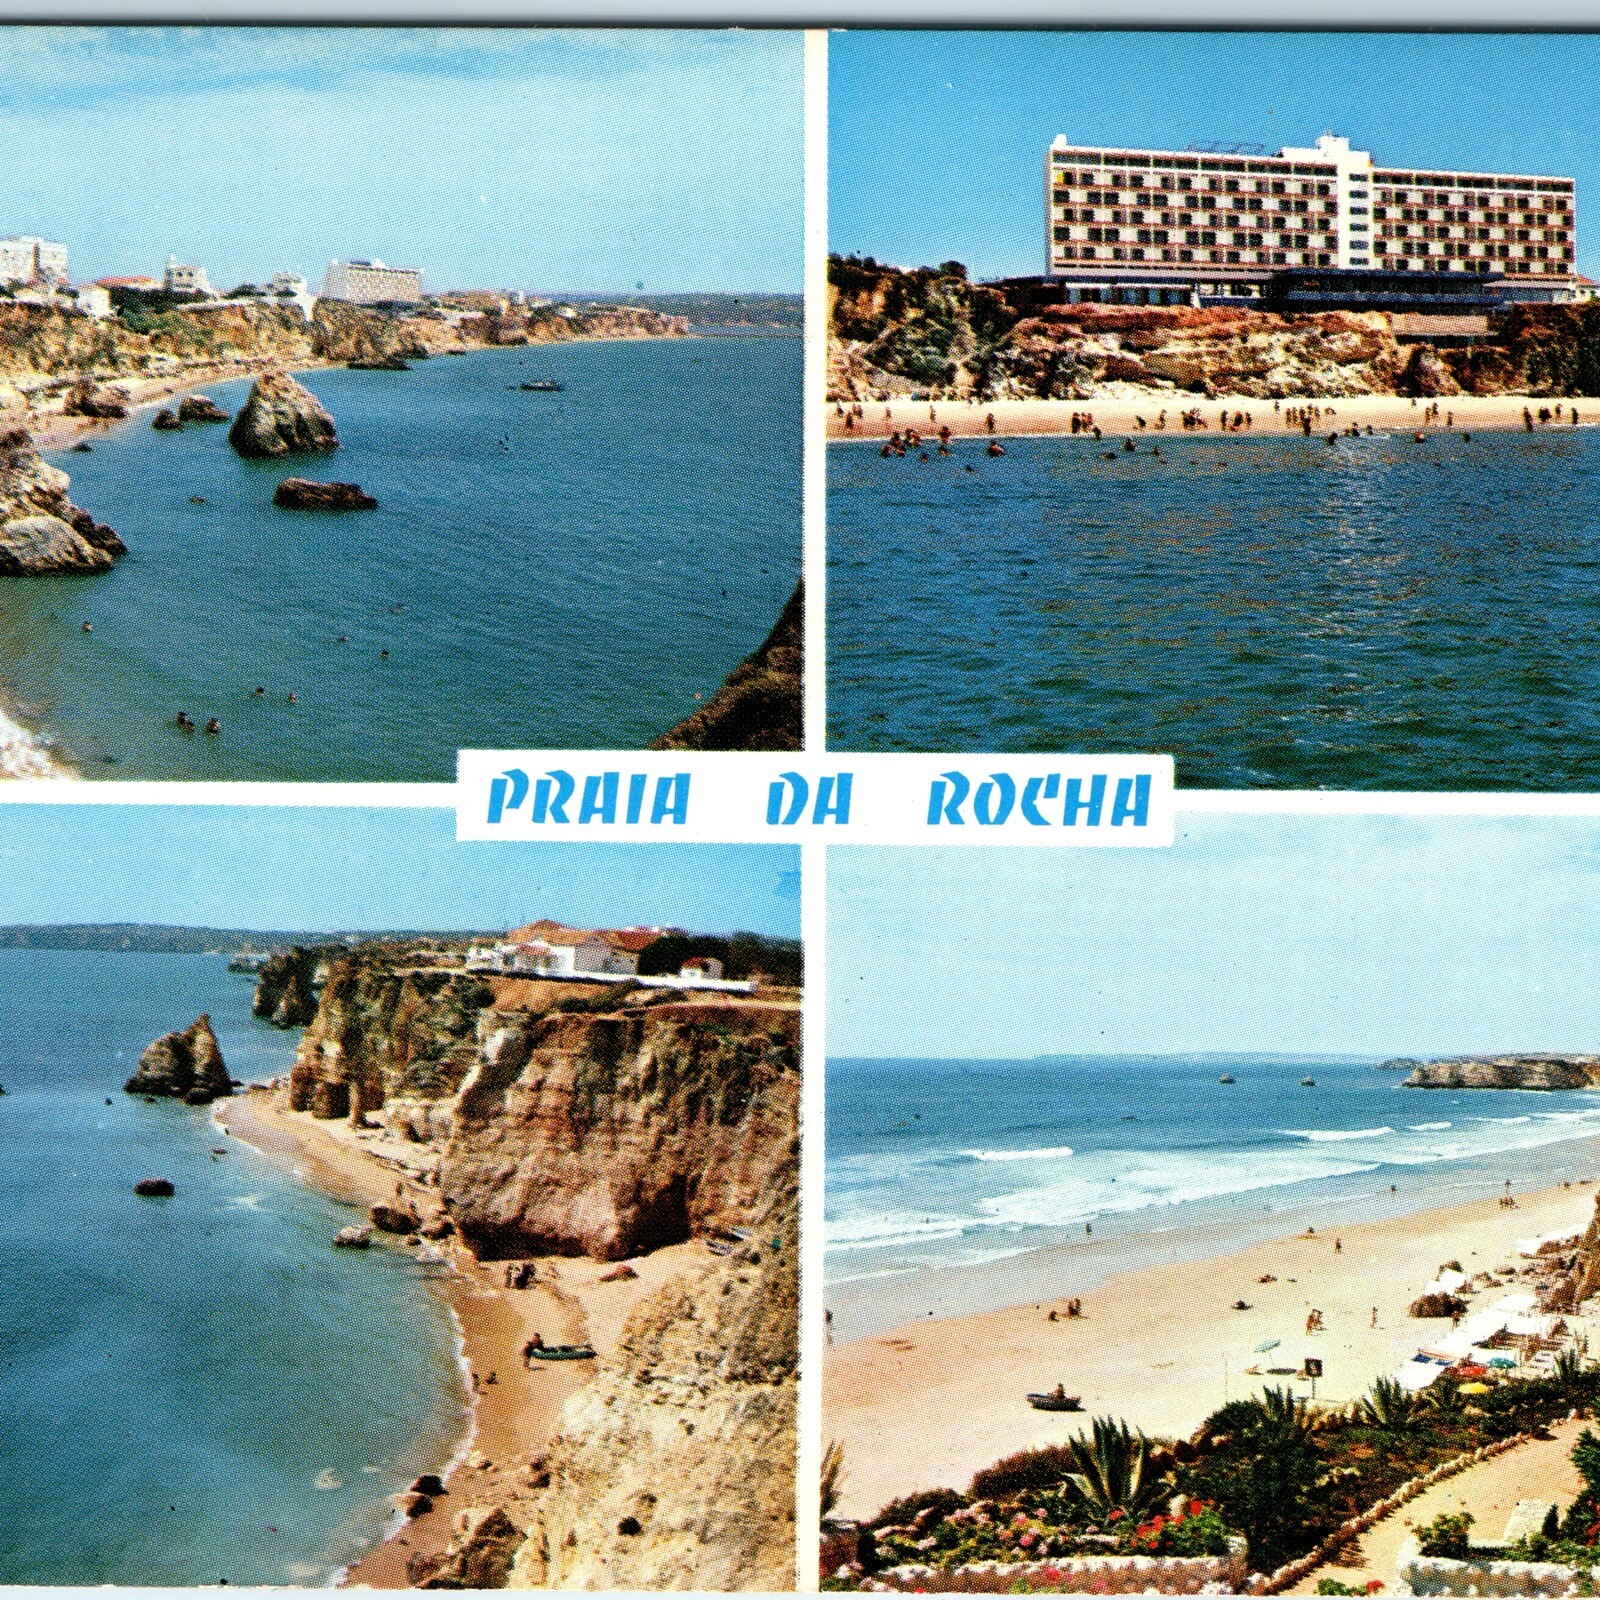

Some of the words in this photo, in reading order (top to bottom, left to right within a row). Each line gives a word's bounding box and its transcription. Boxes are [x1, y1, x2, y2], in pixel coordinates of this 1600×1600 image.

[486, 769, 691, 825] PRAIA
[765, 772, 854, 825] DA
[926, 771, 1152, 827] ROCHA
